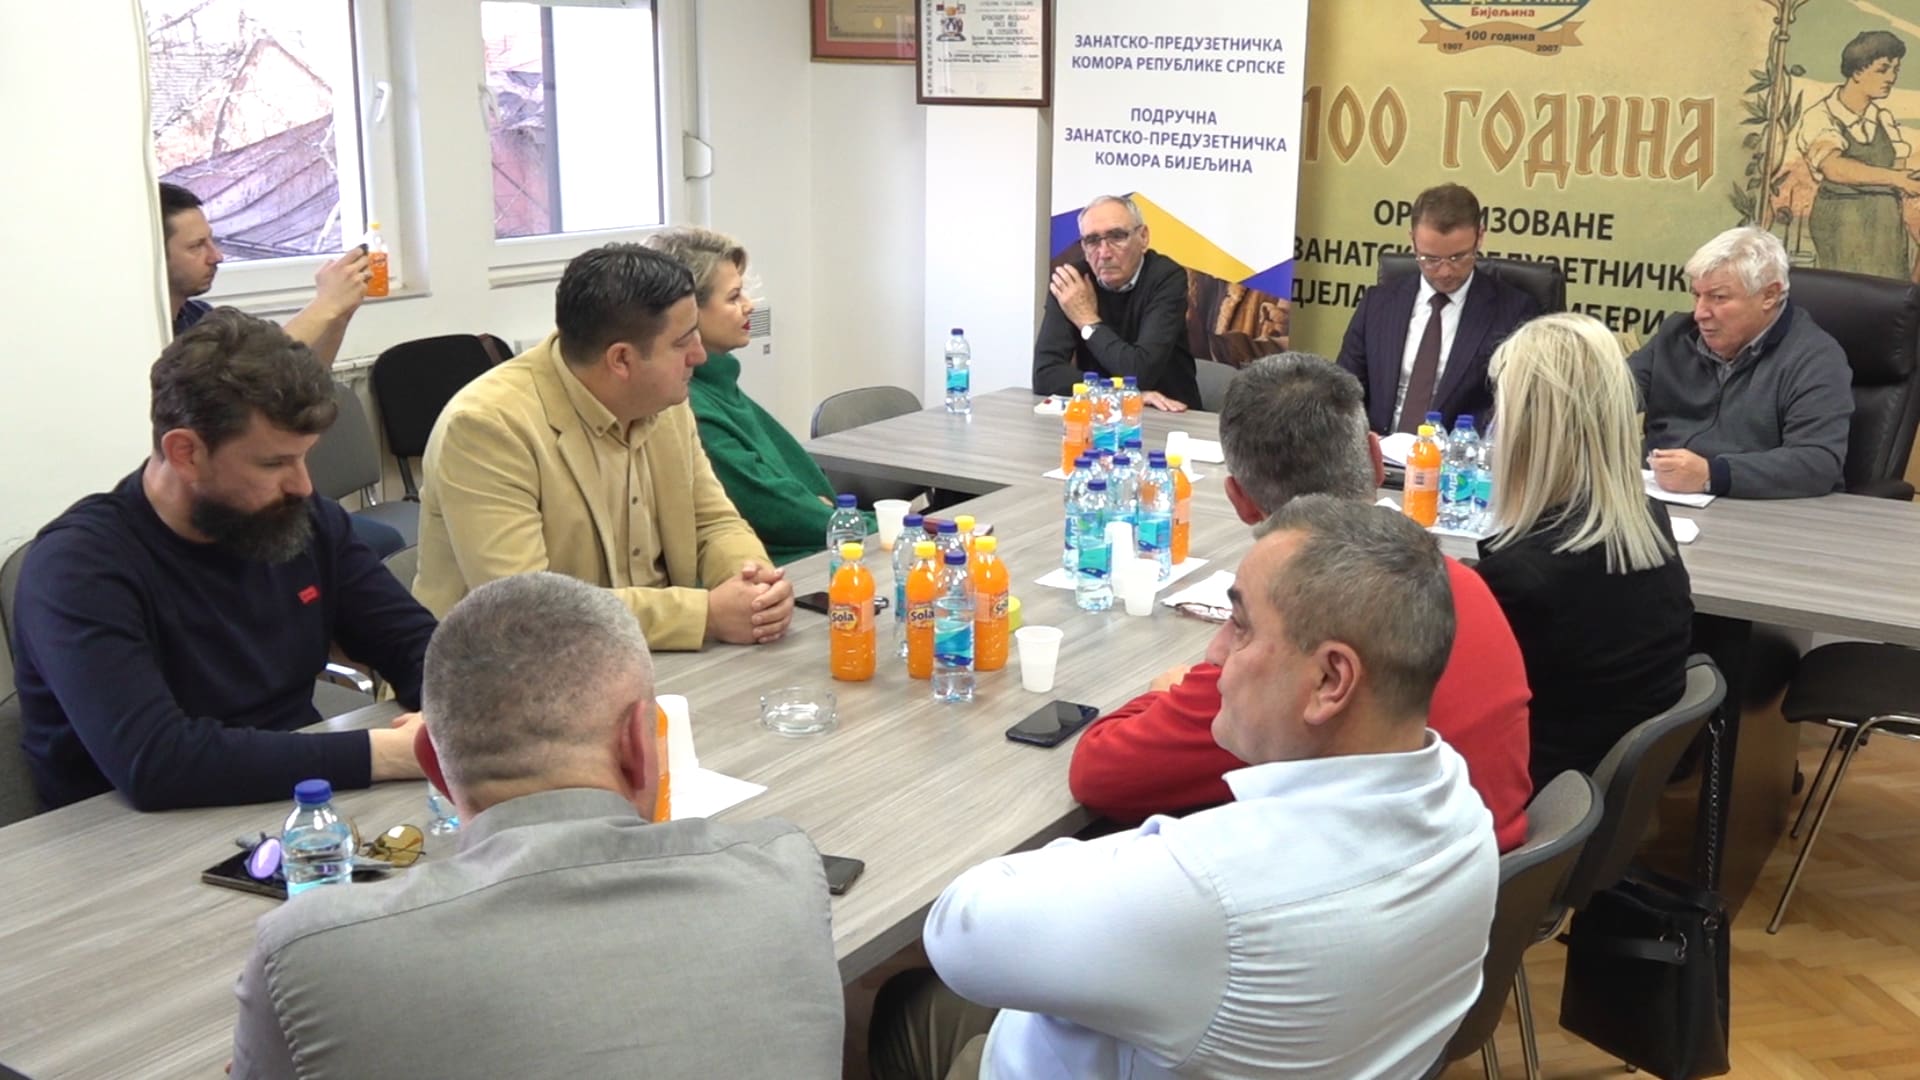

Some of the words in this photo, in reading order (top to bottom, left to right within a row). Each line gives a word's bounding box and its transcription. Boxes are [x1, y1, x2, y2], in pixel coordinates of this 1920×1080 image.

[1471, 6, 1535, 19] Бијељина
[1074, 34, 1283, 52] ЗАНАТСКО-ПРЕДУЗЕТНИЧКА
[1465, 30, 1487, 41] 100
[1491, 32, 1536, 43] година
[1072, 55, 1132, 70] КОМОРА
[1136, 57, 1222, 73] РЕПУБЛИКЕ
[1226, 59, 1285, 74] СРПСКЕ
[1130, 107, 1217, 125] ПОДРУЧНА
[1303, 84, 1408, 166] 100
[1064, 127, 1287, 152] ЗАНАТСКО-ПРЕДУЗЕТНИЧКА
[1095, 151, 1160, 168] КОМОРА
[1164, 154, 1253, 173] БИЈЕЉИНА
[831, 611, 855, 623] Sola
[910, 609, 935, 621] Sola
